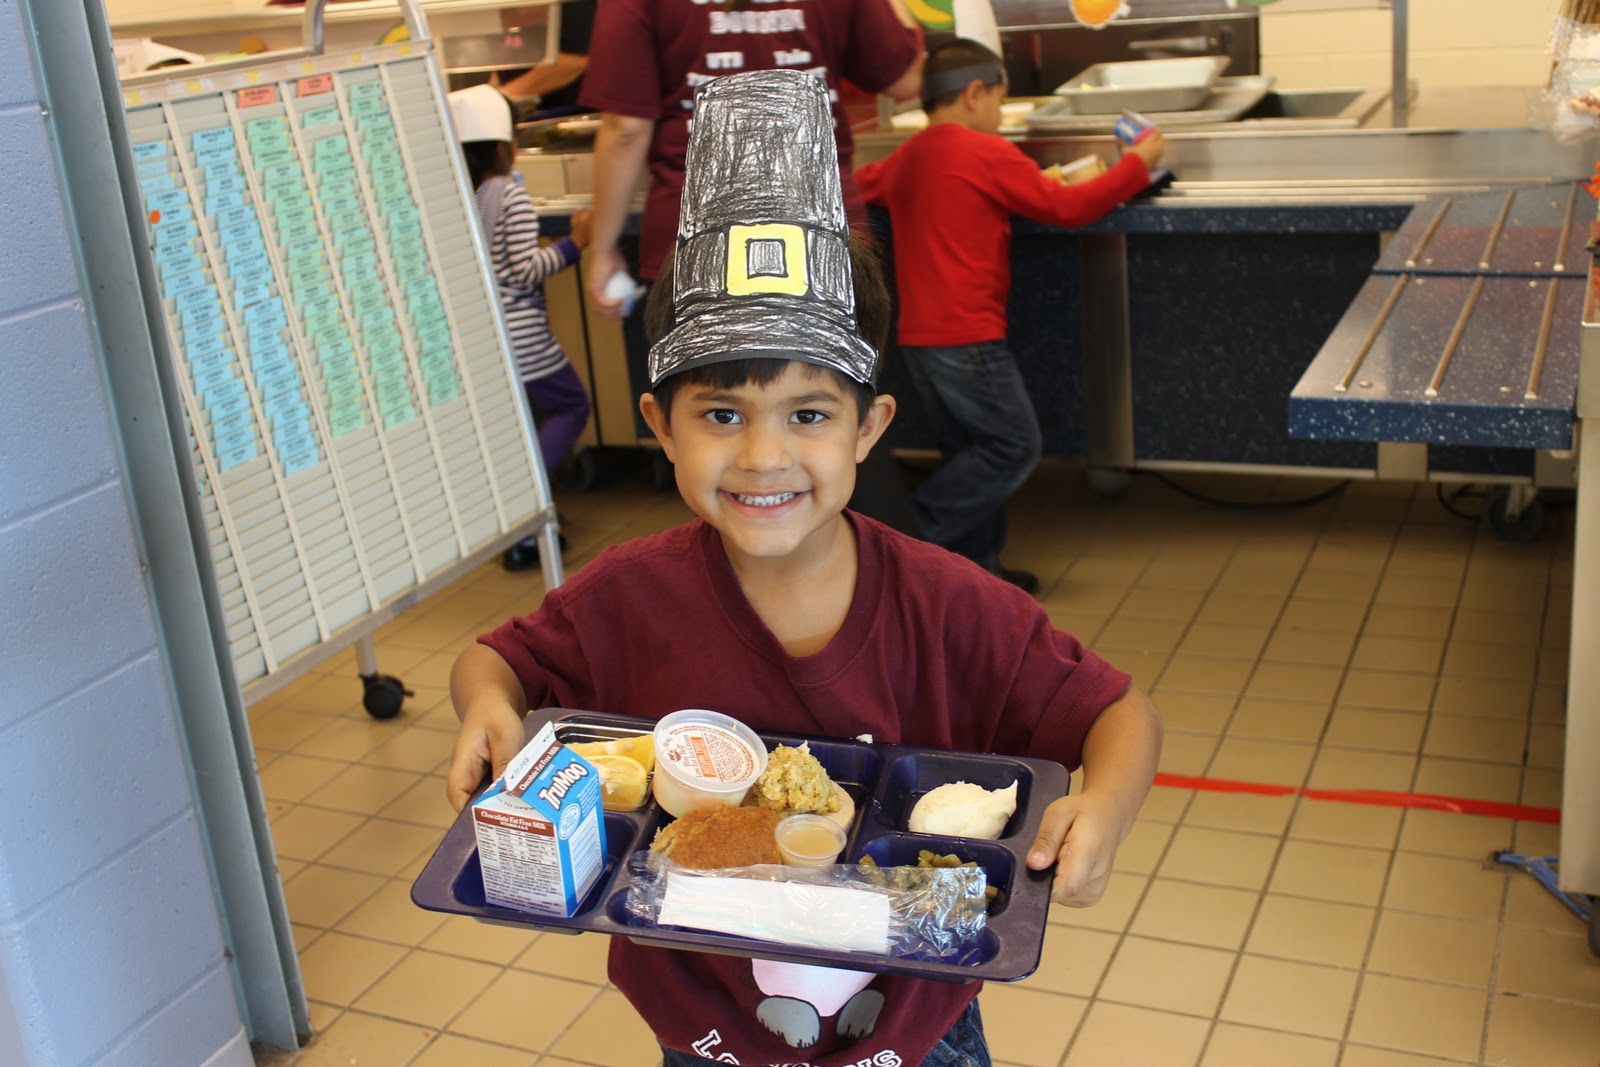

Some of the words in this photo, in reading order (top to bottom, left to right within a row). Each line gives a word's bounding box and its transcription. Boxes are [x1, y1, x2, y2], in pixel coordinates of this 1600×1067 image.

[519, 768, 538, 791] Chocolate
[548, 746, 560, 758] Milk
[538, 761, 589, 811] TruMoo
[480, 811, 509, 823] Chocolate
[509, 816, 520, 825] Fat
[519, 818, 532, 828] Free
[533, 821, 547, 830] Milk
